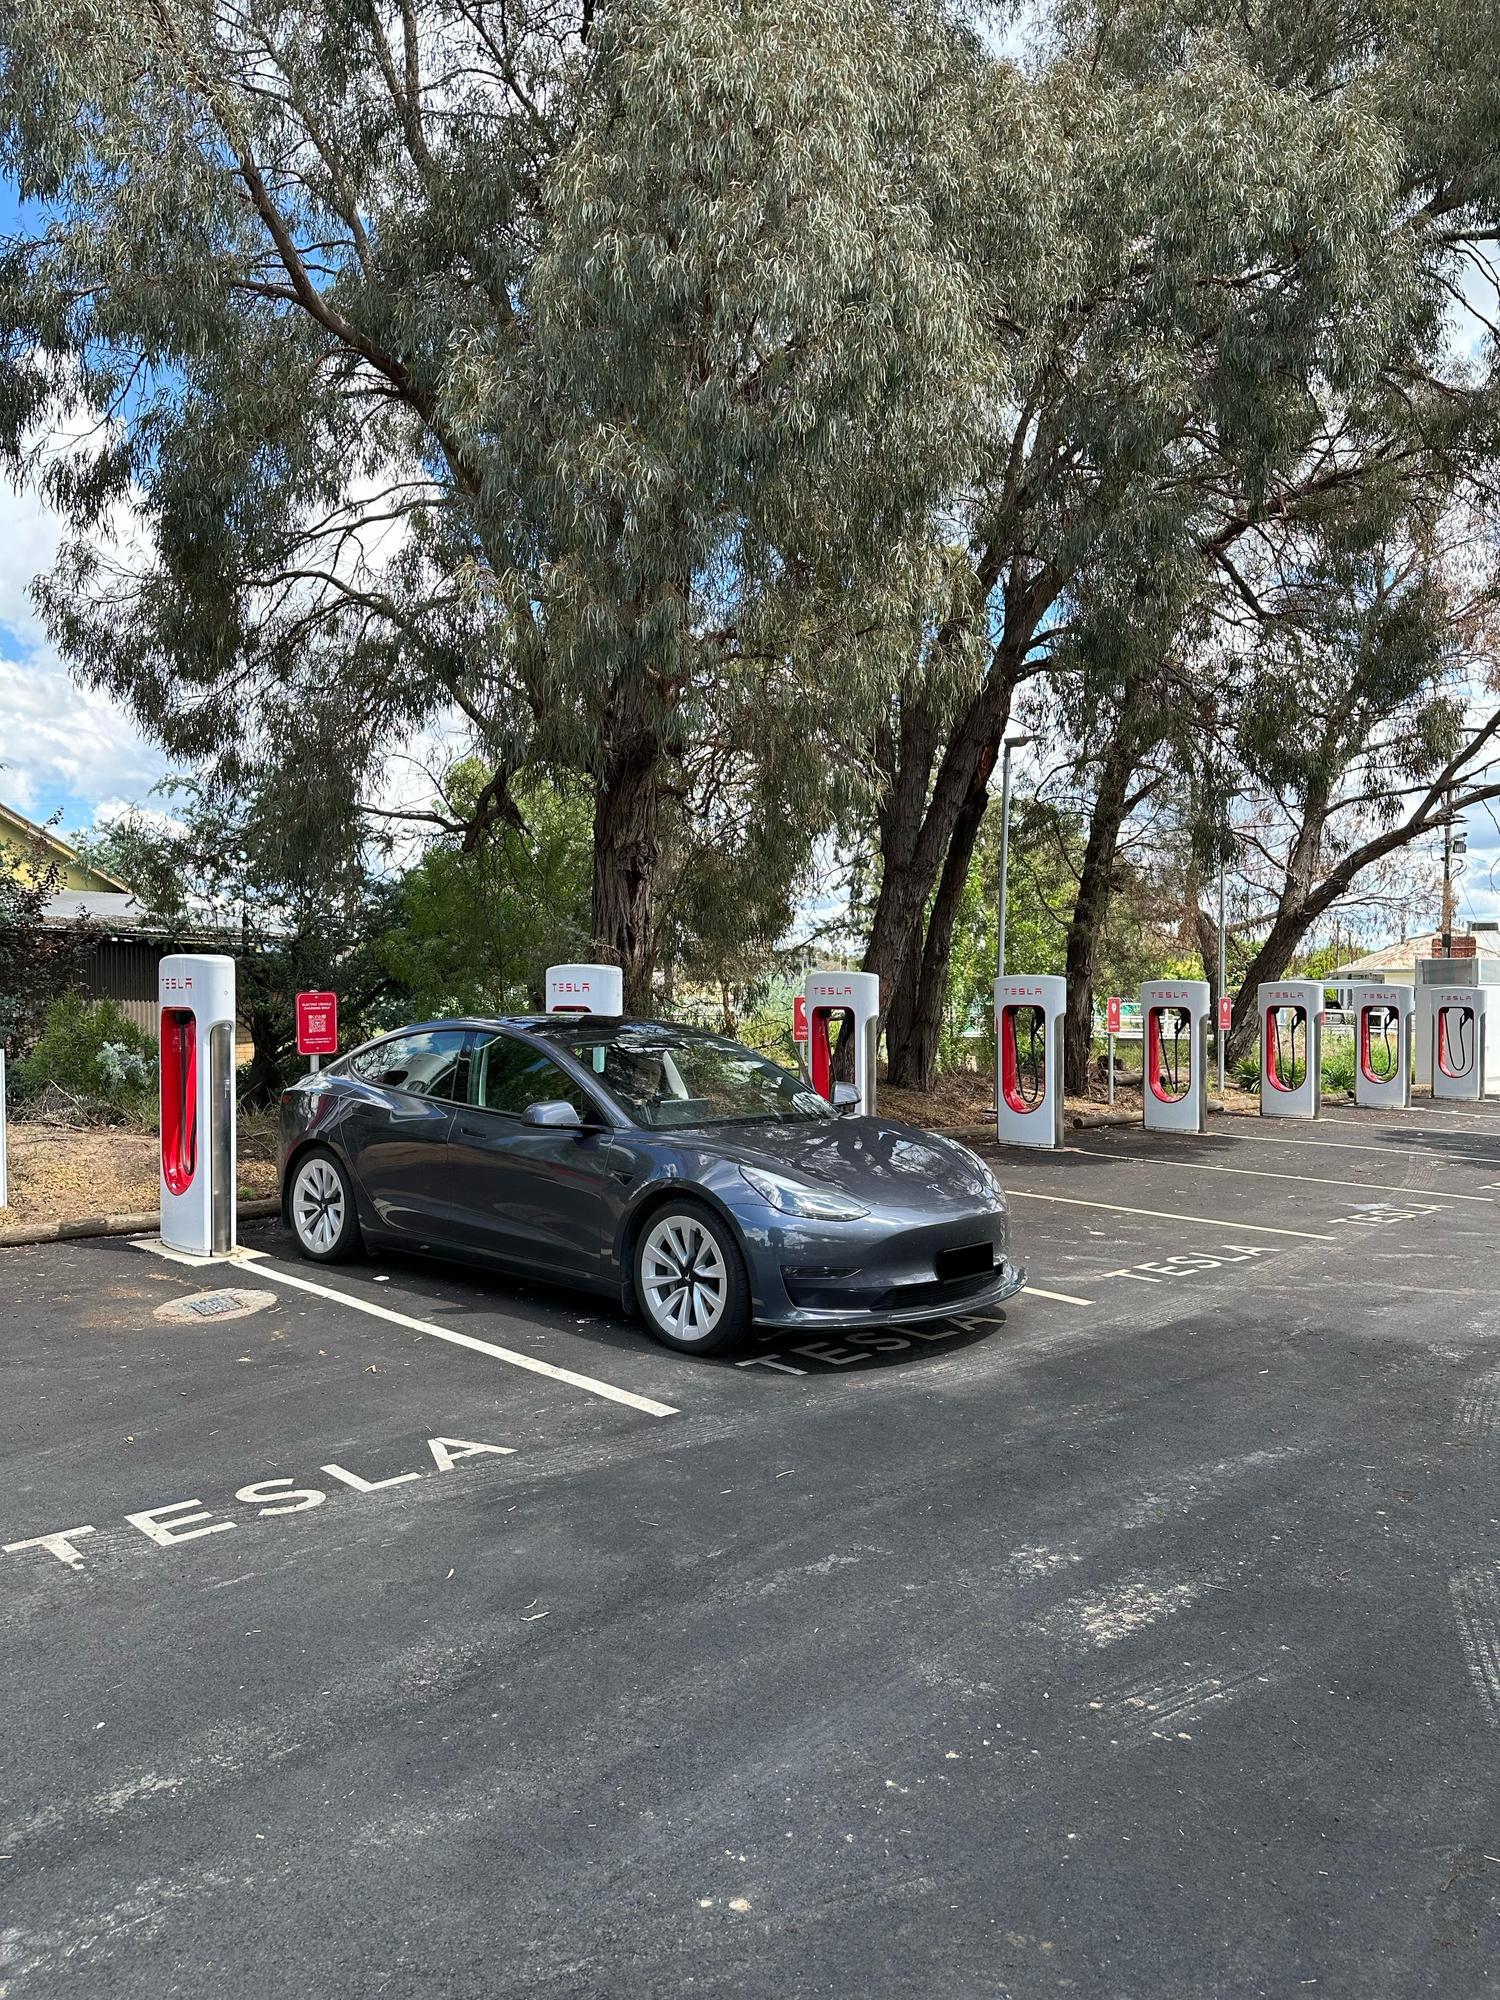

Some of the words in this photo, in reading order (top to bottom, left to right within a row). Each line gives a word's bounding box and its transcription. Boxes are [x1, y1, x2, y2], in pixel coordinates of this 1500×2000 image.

[552, 982, 590, 992] TESLA
[813, 986, 852, 995] TESLA
[1003, 987, 1042, 995] TESLA
[1327, 1203, 1454, 1226] TESLA
[1100, 1244, 1280, 1283] TESLA
[734, 1315, 1006, 1376] TESLA
[1, 1436, 518, 1570] TESLA
